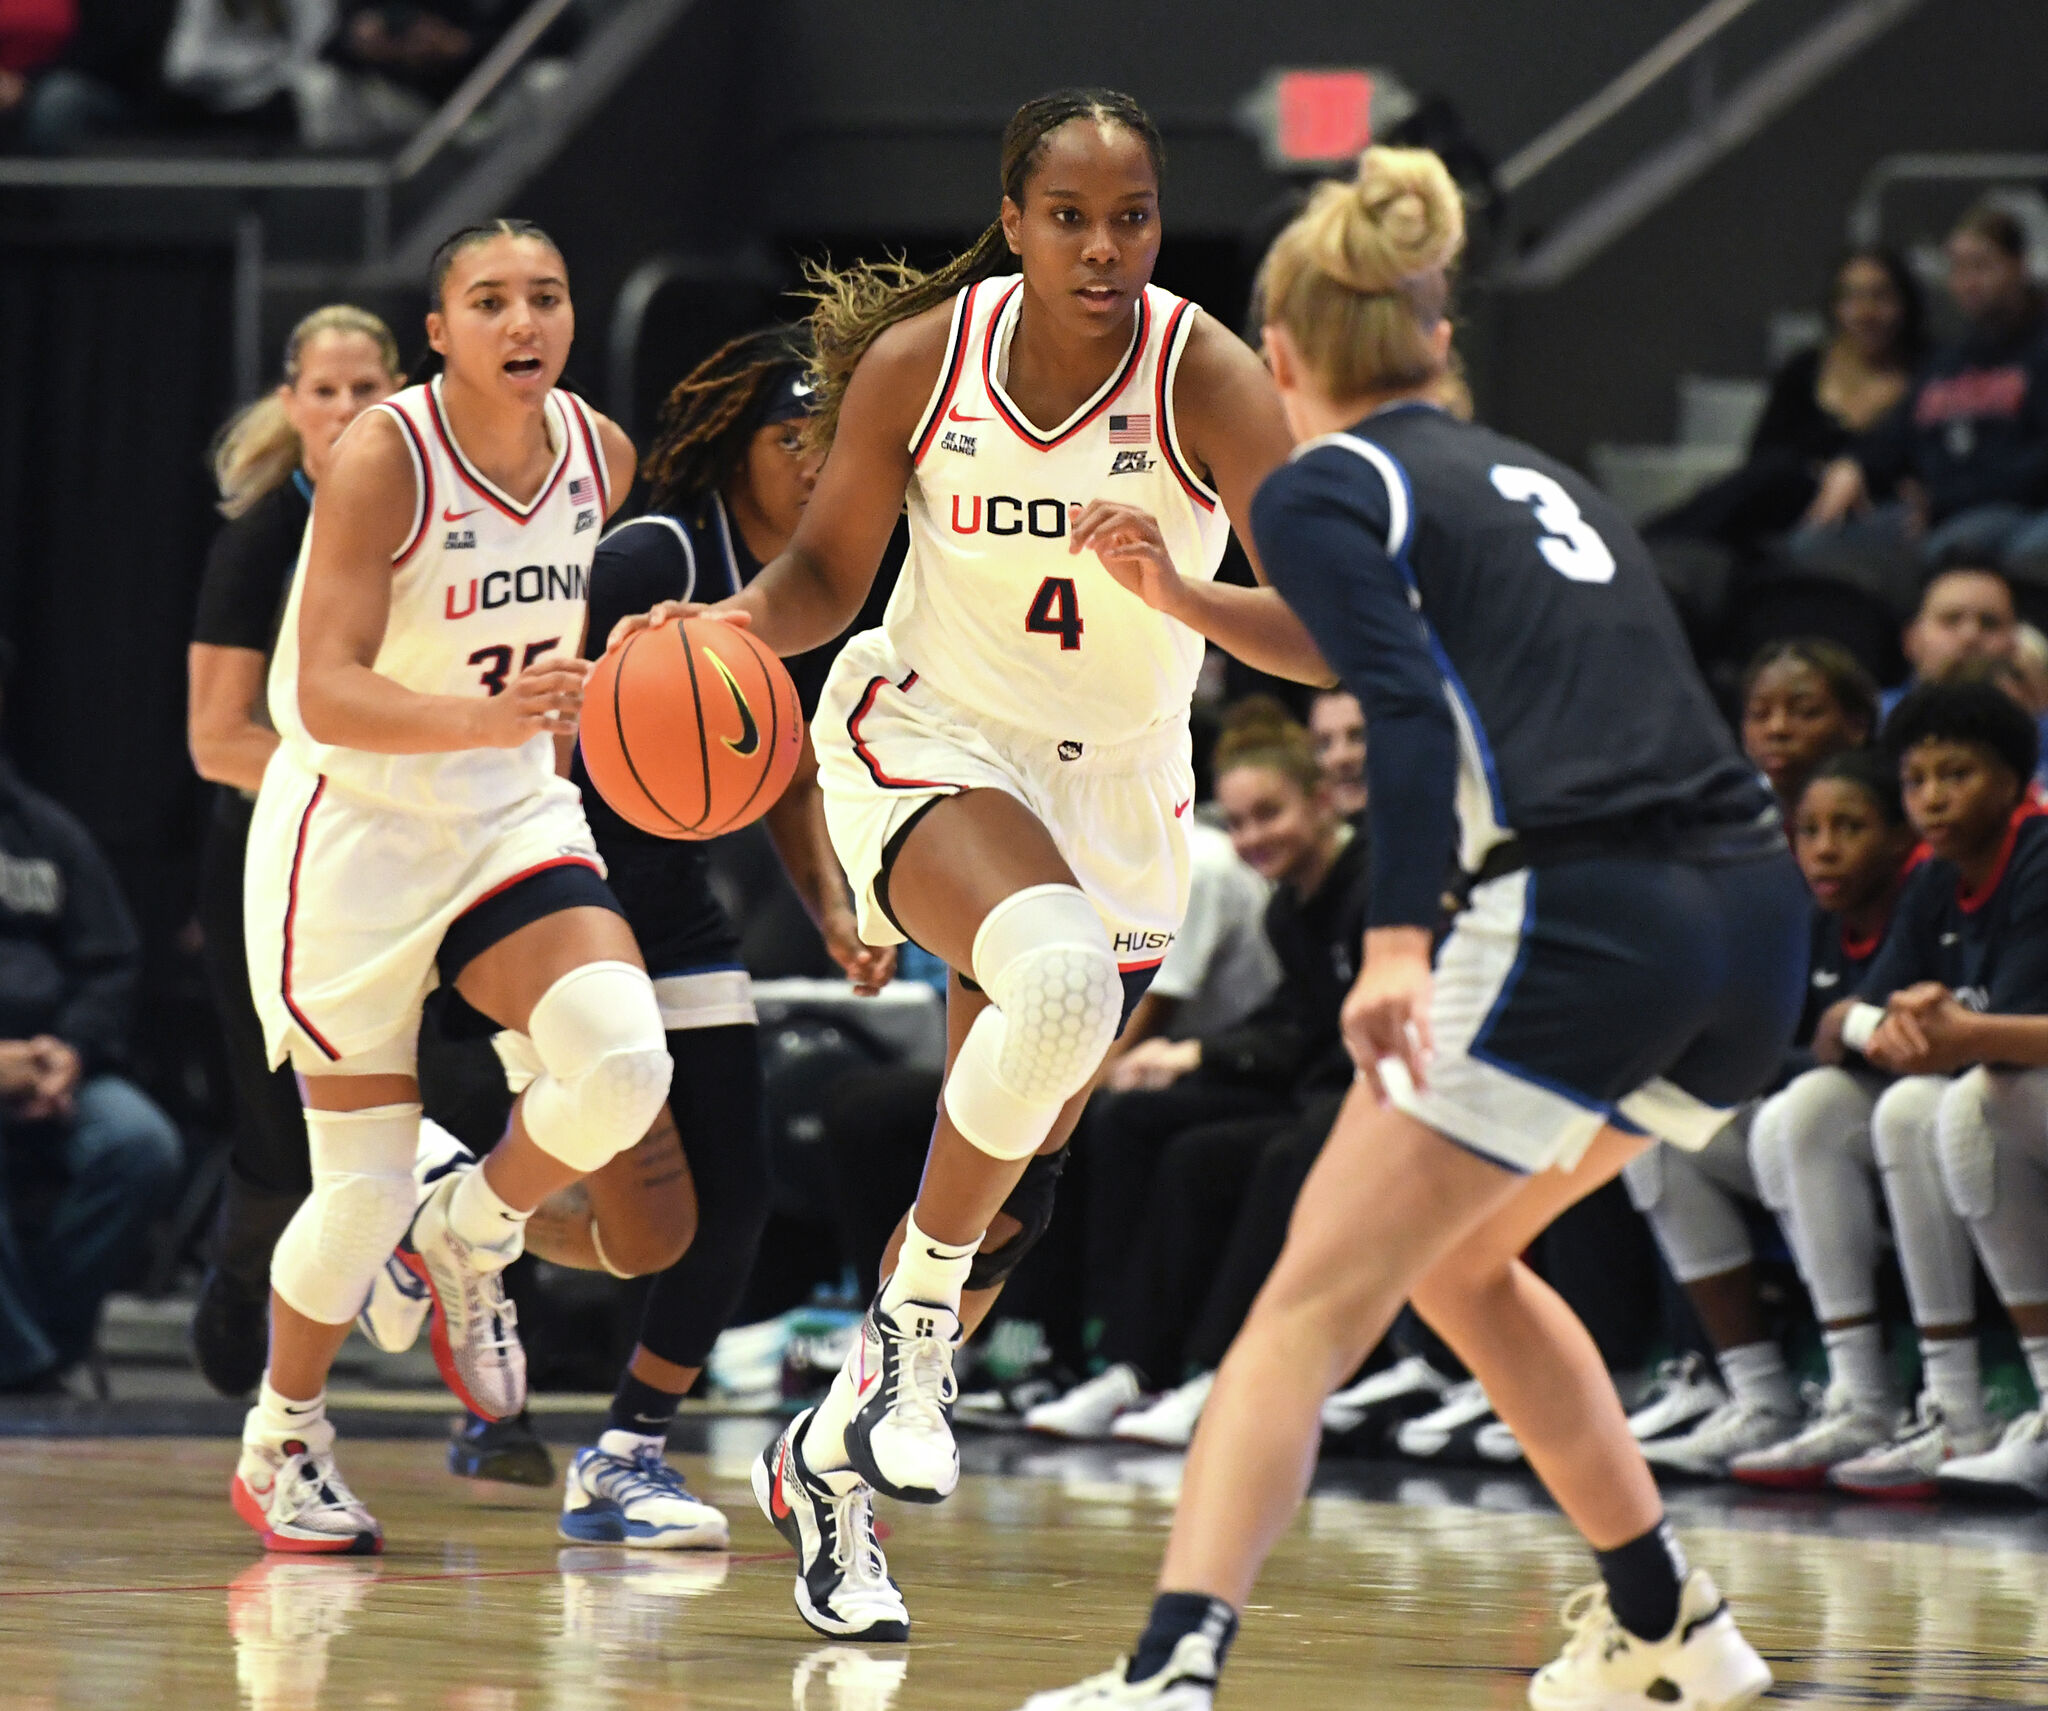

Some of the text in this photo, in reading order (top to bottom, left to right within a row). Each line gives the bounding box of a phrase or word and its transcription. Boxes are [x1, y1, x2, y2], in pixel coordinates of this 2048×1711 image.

[941, 440, 976, 457] CHANGE
[945, 431, 957, 441] BE
[952, 495, 1083, 538] UCO
[1489, 463, 1617, 584] 3
[1025, 576, 1084, 650] 4
